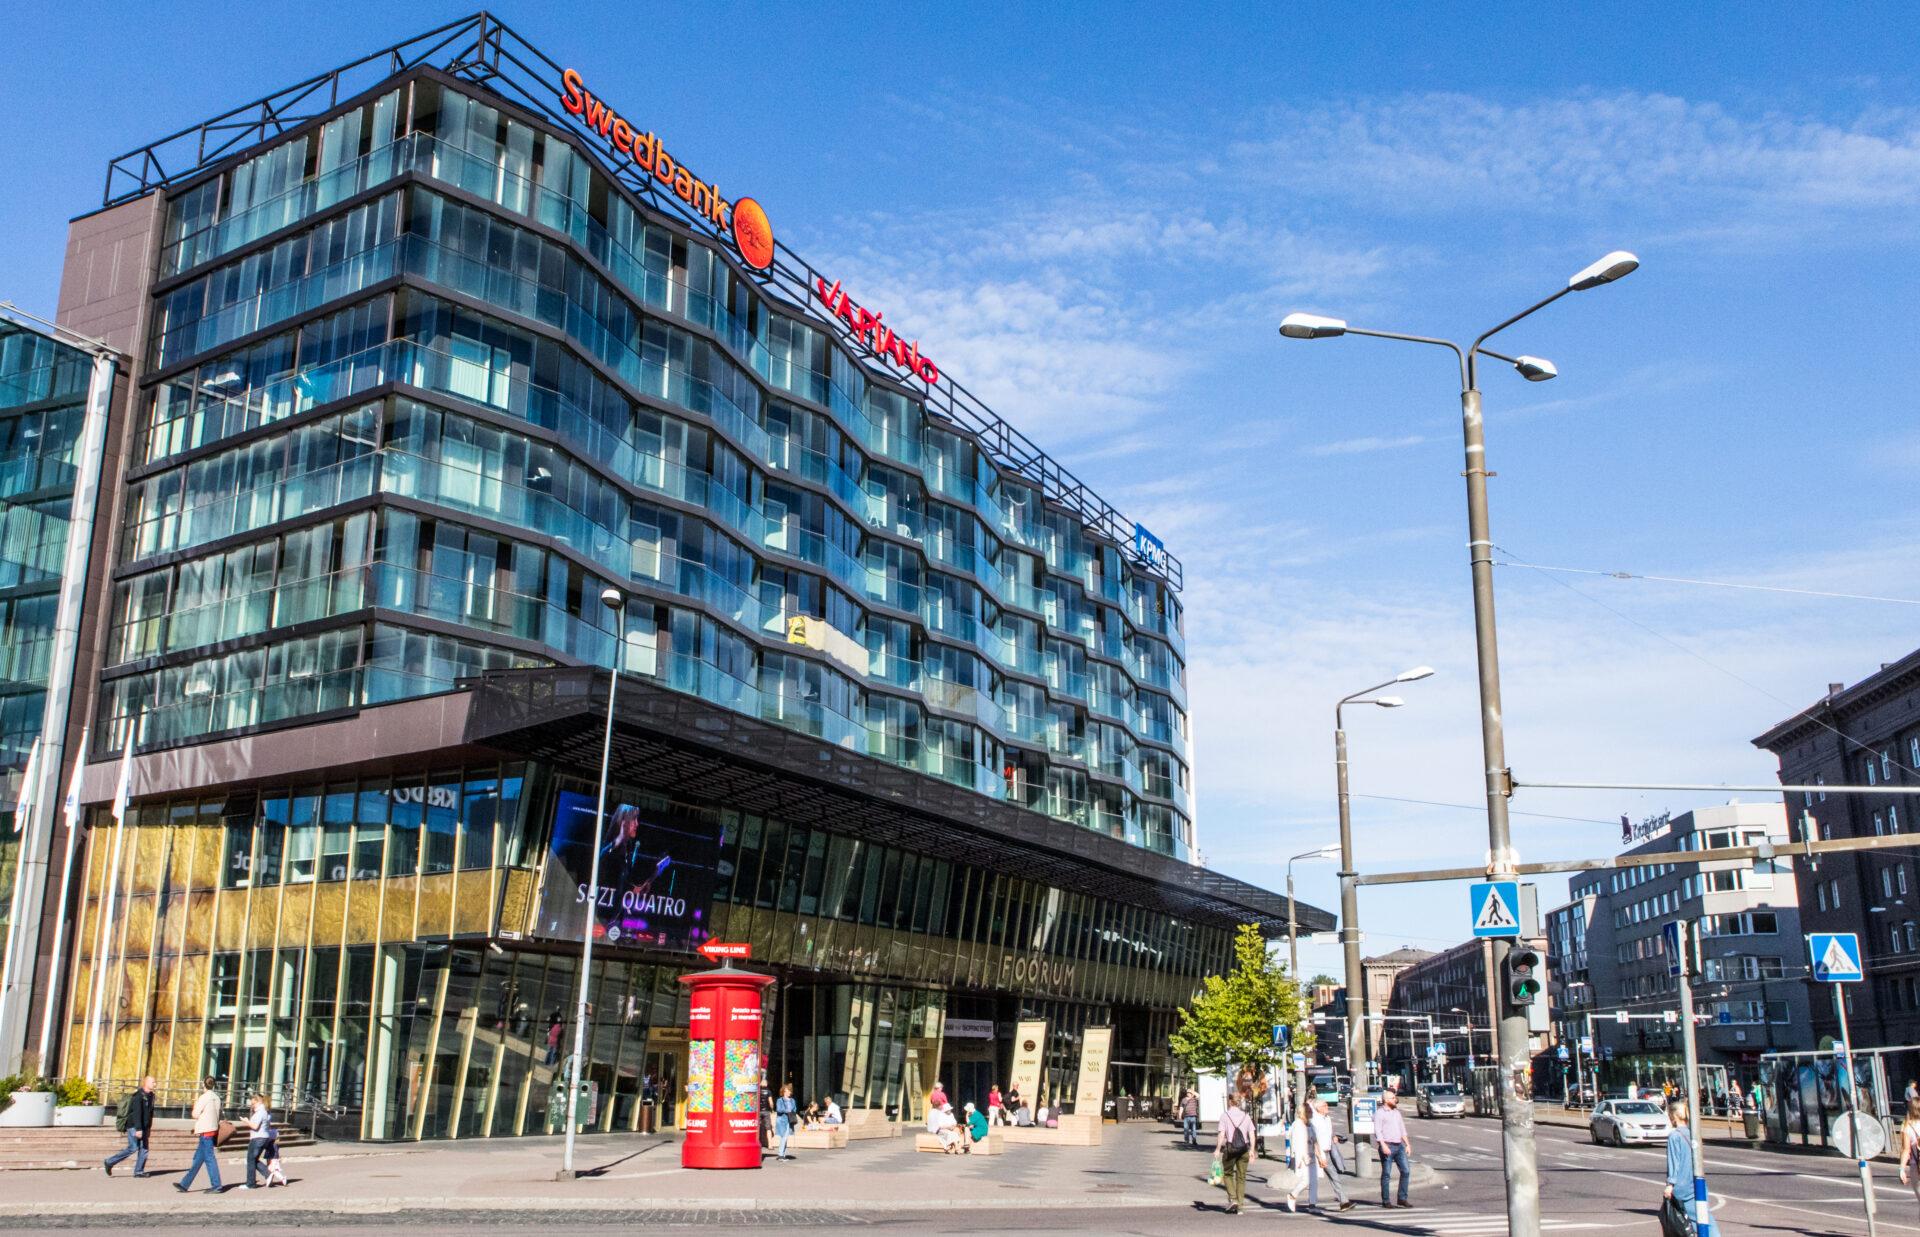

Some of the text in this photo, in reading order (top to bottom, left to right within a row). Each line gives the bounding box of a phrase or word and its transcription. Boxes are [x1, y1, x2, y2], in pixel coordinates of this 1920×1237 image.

[560, 68, 729, 231] Swedbank
[1140, 535, 1167, 570] KPMG
[622, 891, 686, 917] QUATRO
